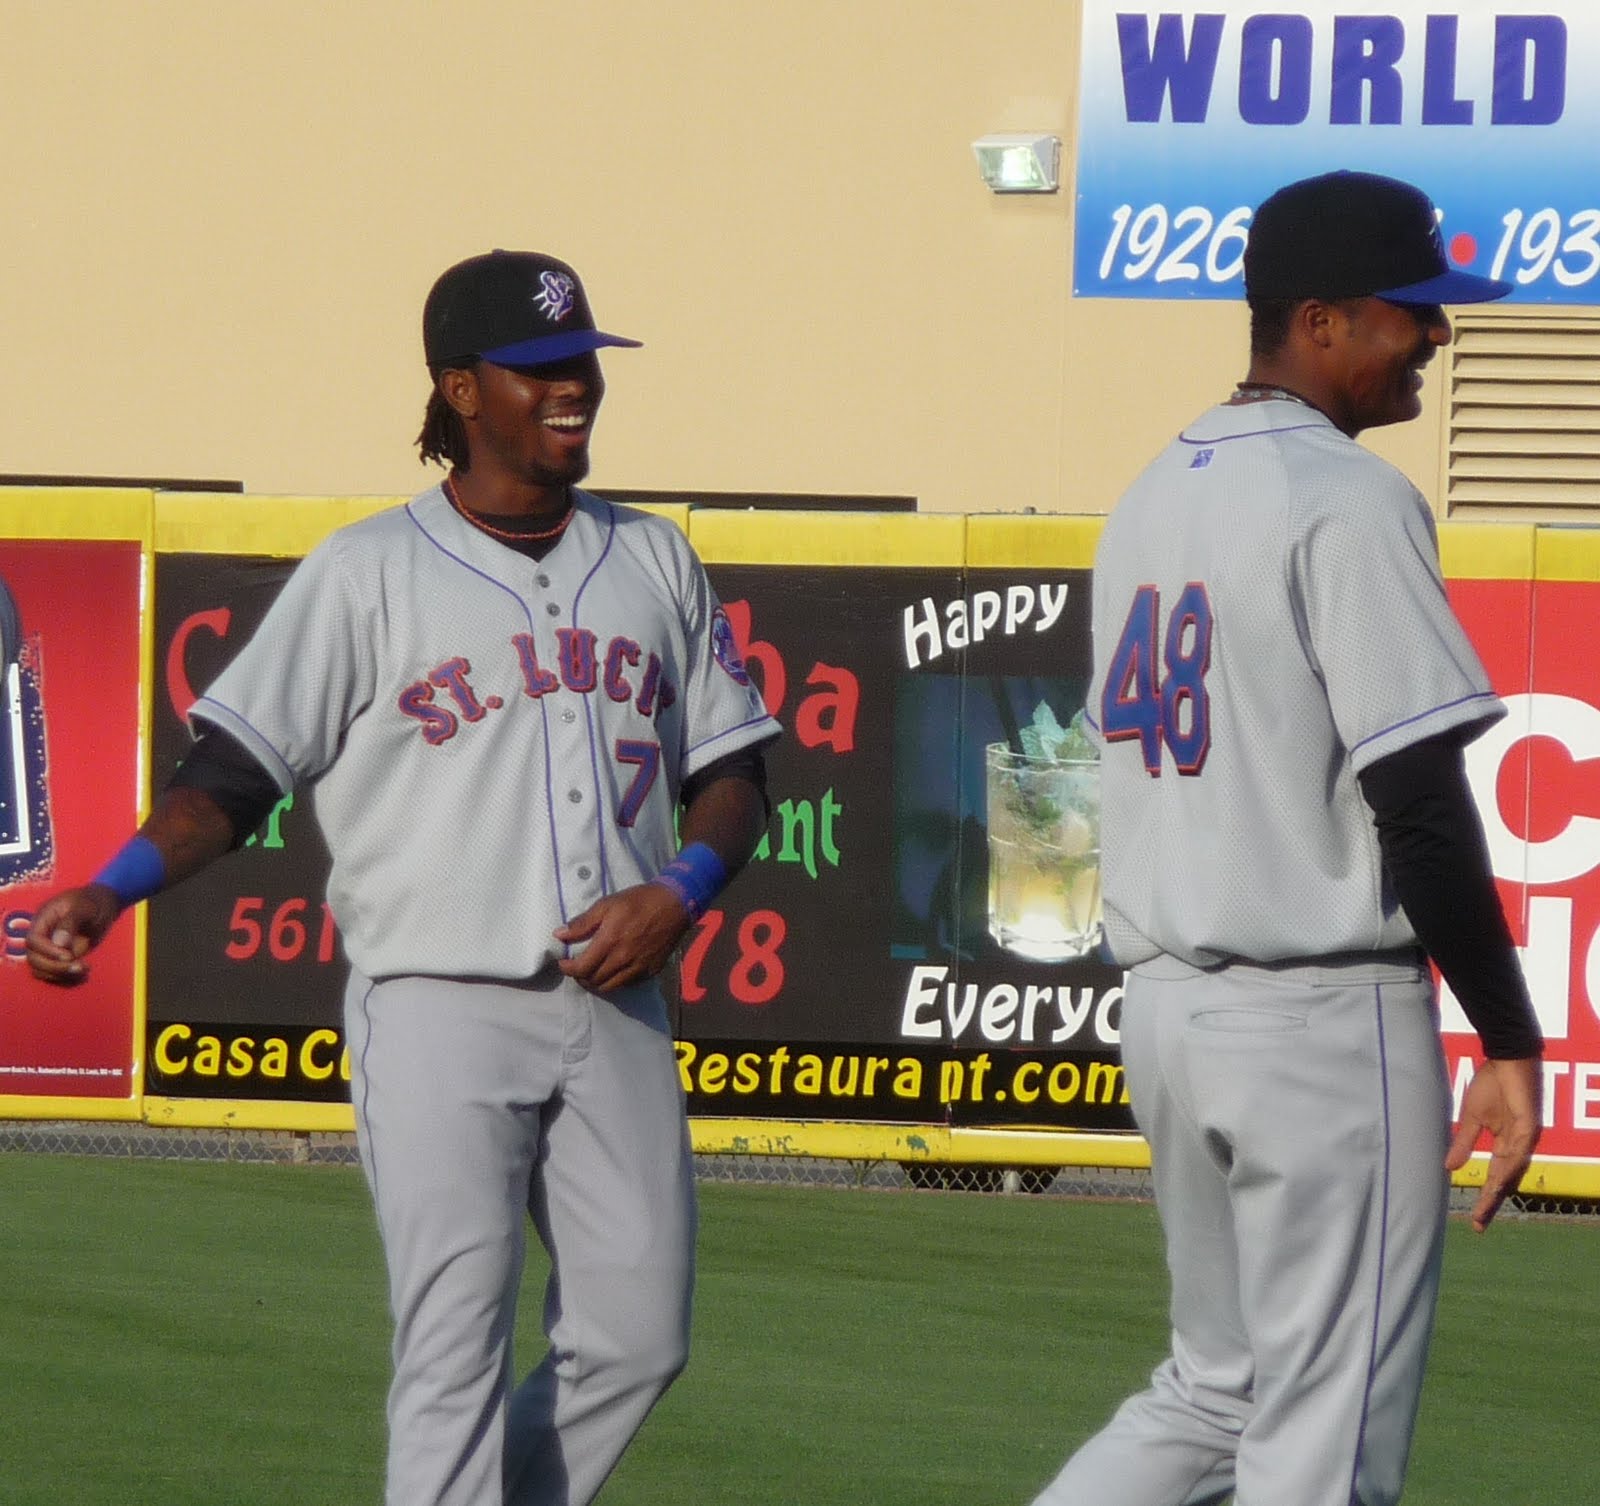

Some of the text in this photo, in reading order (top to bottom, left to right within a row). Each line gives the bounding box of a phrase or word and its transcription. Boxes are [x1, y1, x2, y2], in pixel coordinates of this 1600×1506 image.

[1116, 13, 1567, 126] WORLD
[1099, 204, 1251, 283] 1926
[904, 584, 1068, 669] Happy
[399, 656, 504, 746] ST.
[511, 627, 676, 717] LUCI
[1102, 581, 1213, 778] 48
[616, 738, 660, 828] 7
